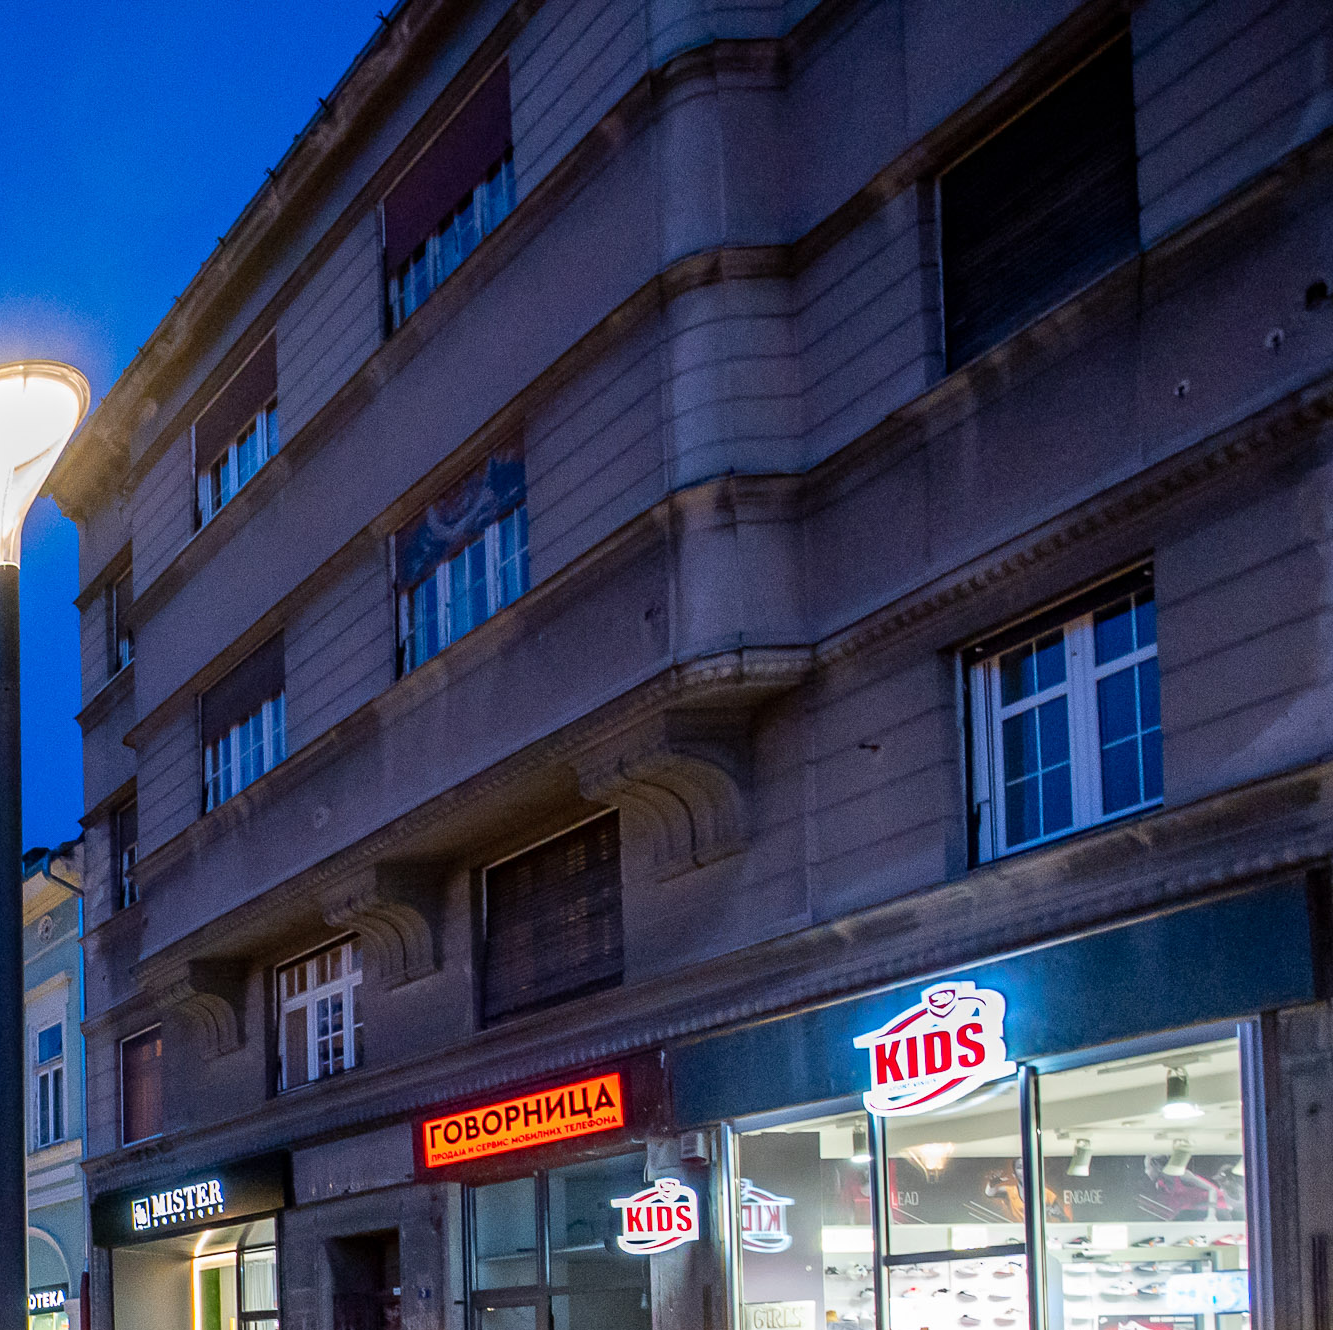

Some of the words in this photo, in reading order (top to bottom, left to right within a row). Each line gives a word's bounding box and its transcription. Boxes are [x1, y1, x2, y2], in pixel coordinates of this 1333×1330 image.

[875, 1022, 986, 1085] KIDS
[429, 1082, 616, 1149] ГОВОРНИЦА
[431, 1148, 466, 1162] ПРОДАЈА
[468, 1145, 475, 1153] И
[476, 1138, 510, 1152] СЕРВИС
[511, 1128, 563, 1145] МОБИЛНИХ
[564, 1114, 618, 1134] ТЕЛЕФОНА
[151, 1179, 224, 1218] MISTER
[891, 1191, 919, 1206] LEAD
[1063, 1189, 1104, 1205] ENGAGE
[153, 1205, 224, 1227] BOUTIQUE
[626, 1205, 693, 1233] KIDS
